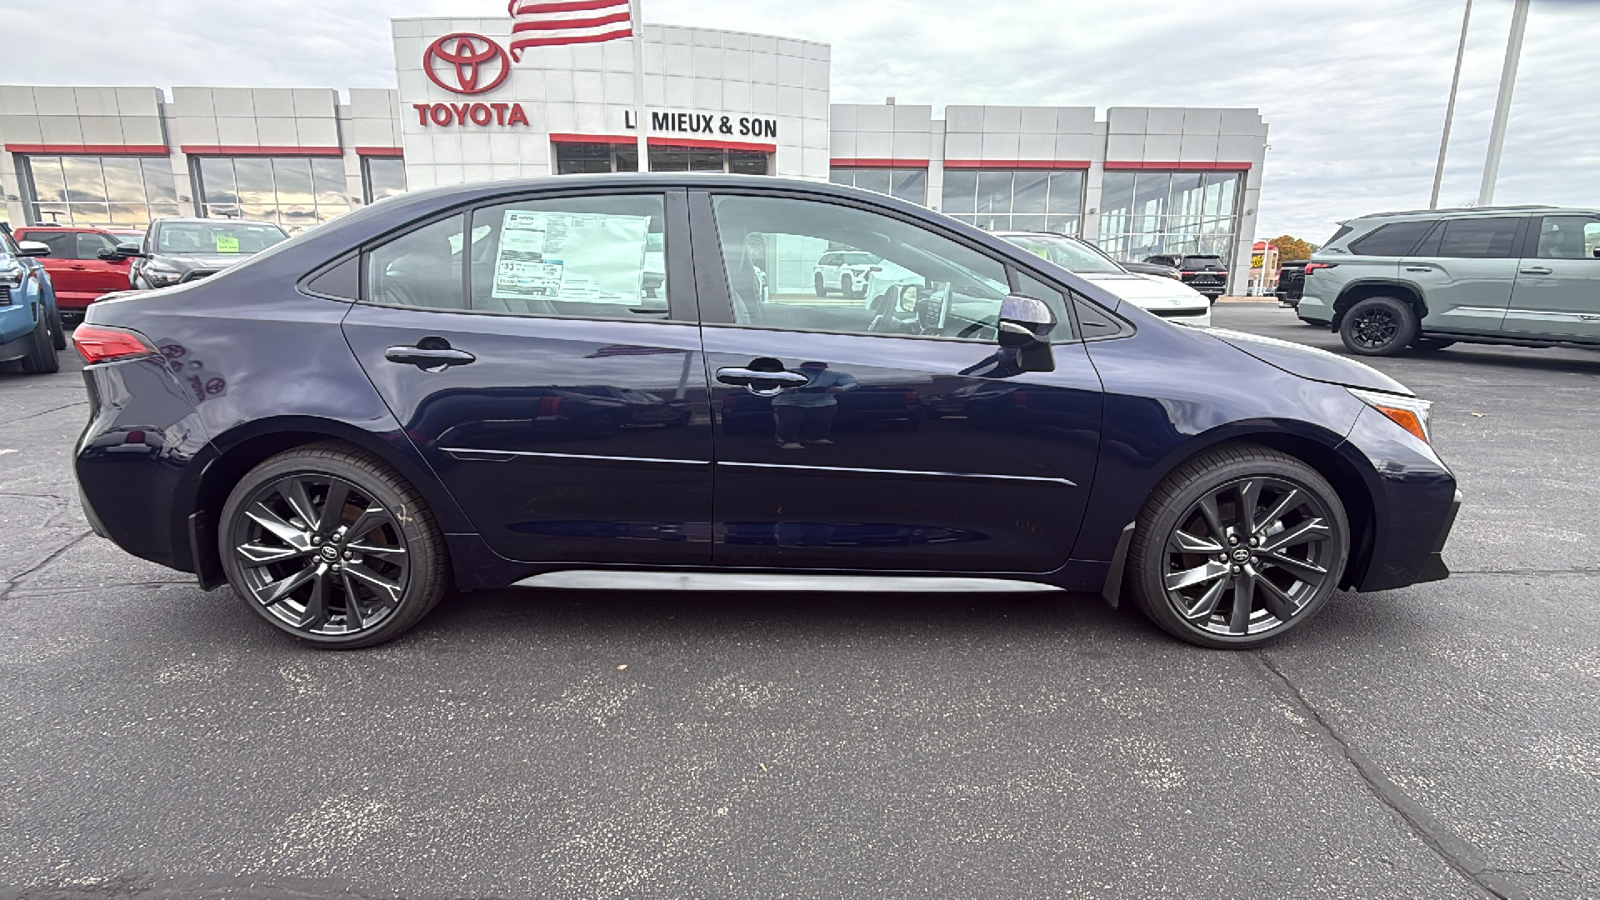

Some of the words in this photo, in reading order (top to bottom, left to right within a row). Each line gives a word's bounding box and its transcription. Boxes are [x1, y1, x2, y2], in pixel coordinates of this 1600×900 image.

[413, 103, 529, 126] TOYOTA
[625, 110, 637, 129] L
[652, 111, 713, 134] MIEUX
[719, 115, 733, 134] &
[739, 118, 777, 138] SON
